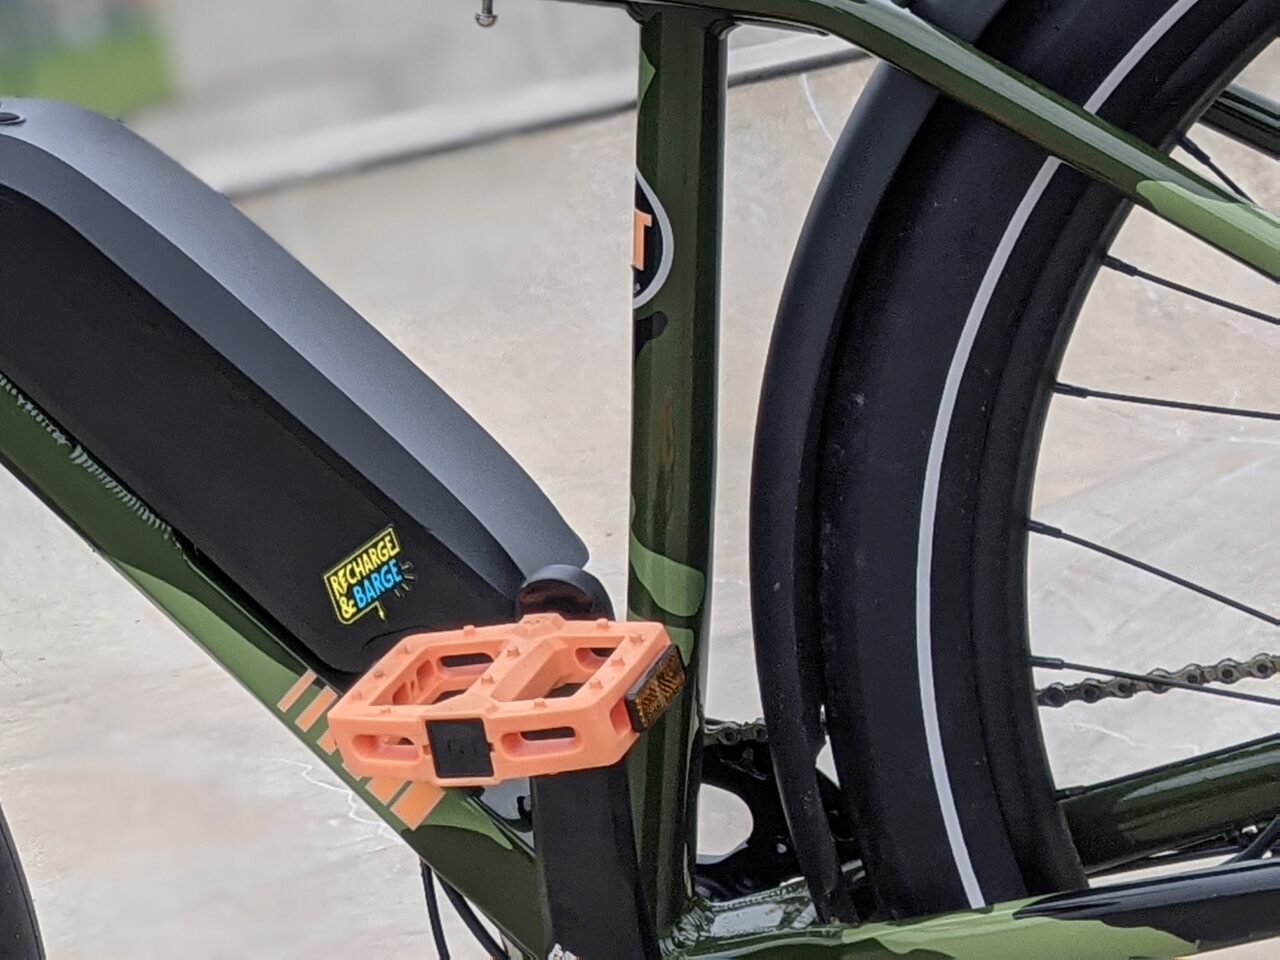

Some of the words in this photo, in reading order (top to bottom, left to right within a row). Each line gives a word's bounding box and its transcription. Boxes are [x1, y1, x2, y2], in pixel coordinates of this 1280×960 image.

[329, 535, 396, 600] RECHARGE
[339, 596, 358, 619] &
[352, 558, 403, 609] BARGE
